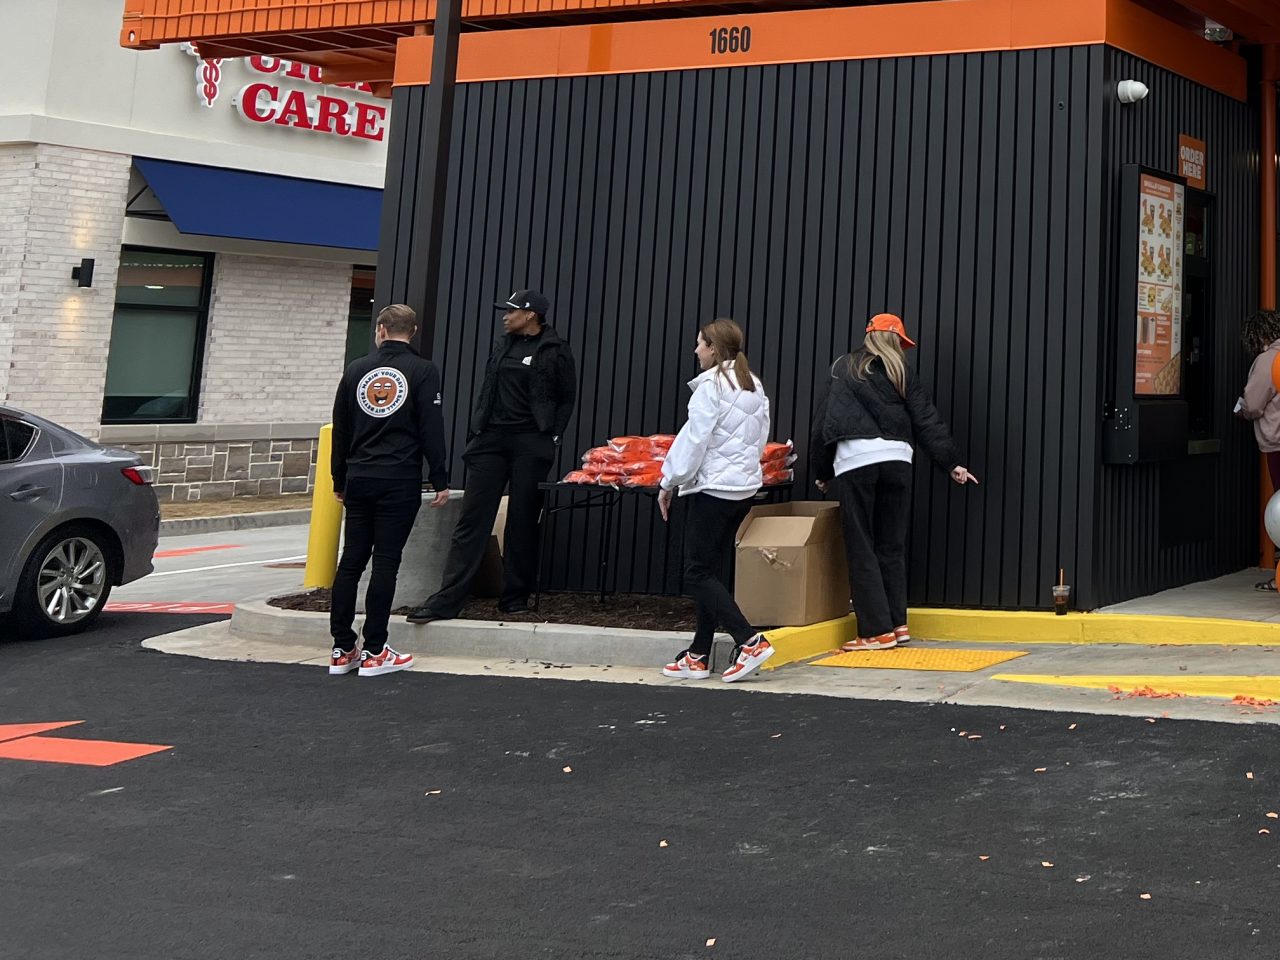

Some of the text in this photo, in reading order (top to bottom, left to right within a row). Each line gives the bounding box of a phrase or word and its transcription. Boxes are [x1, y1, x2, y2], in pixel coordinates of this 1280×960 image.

[709, 25, 752, 55] 1660
[241, 82, 387, 142] CARE
[1180, 145, 1204, 166] ORDER
[1182, 160, 1202, 180] HERE
[380, 371, 397, 379] YOUR
[395, 377, 404, 388] DAY
[388, 395, 403, 411] SMALL
